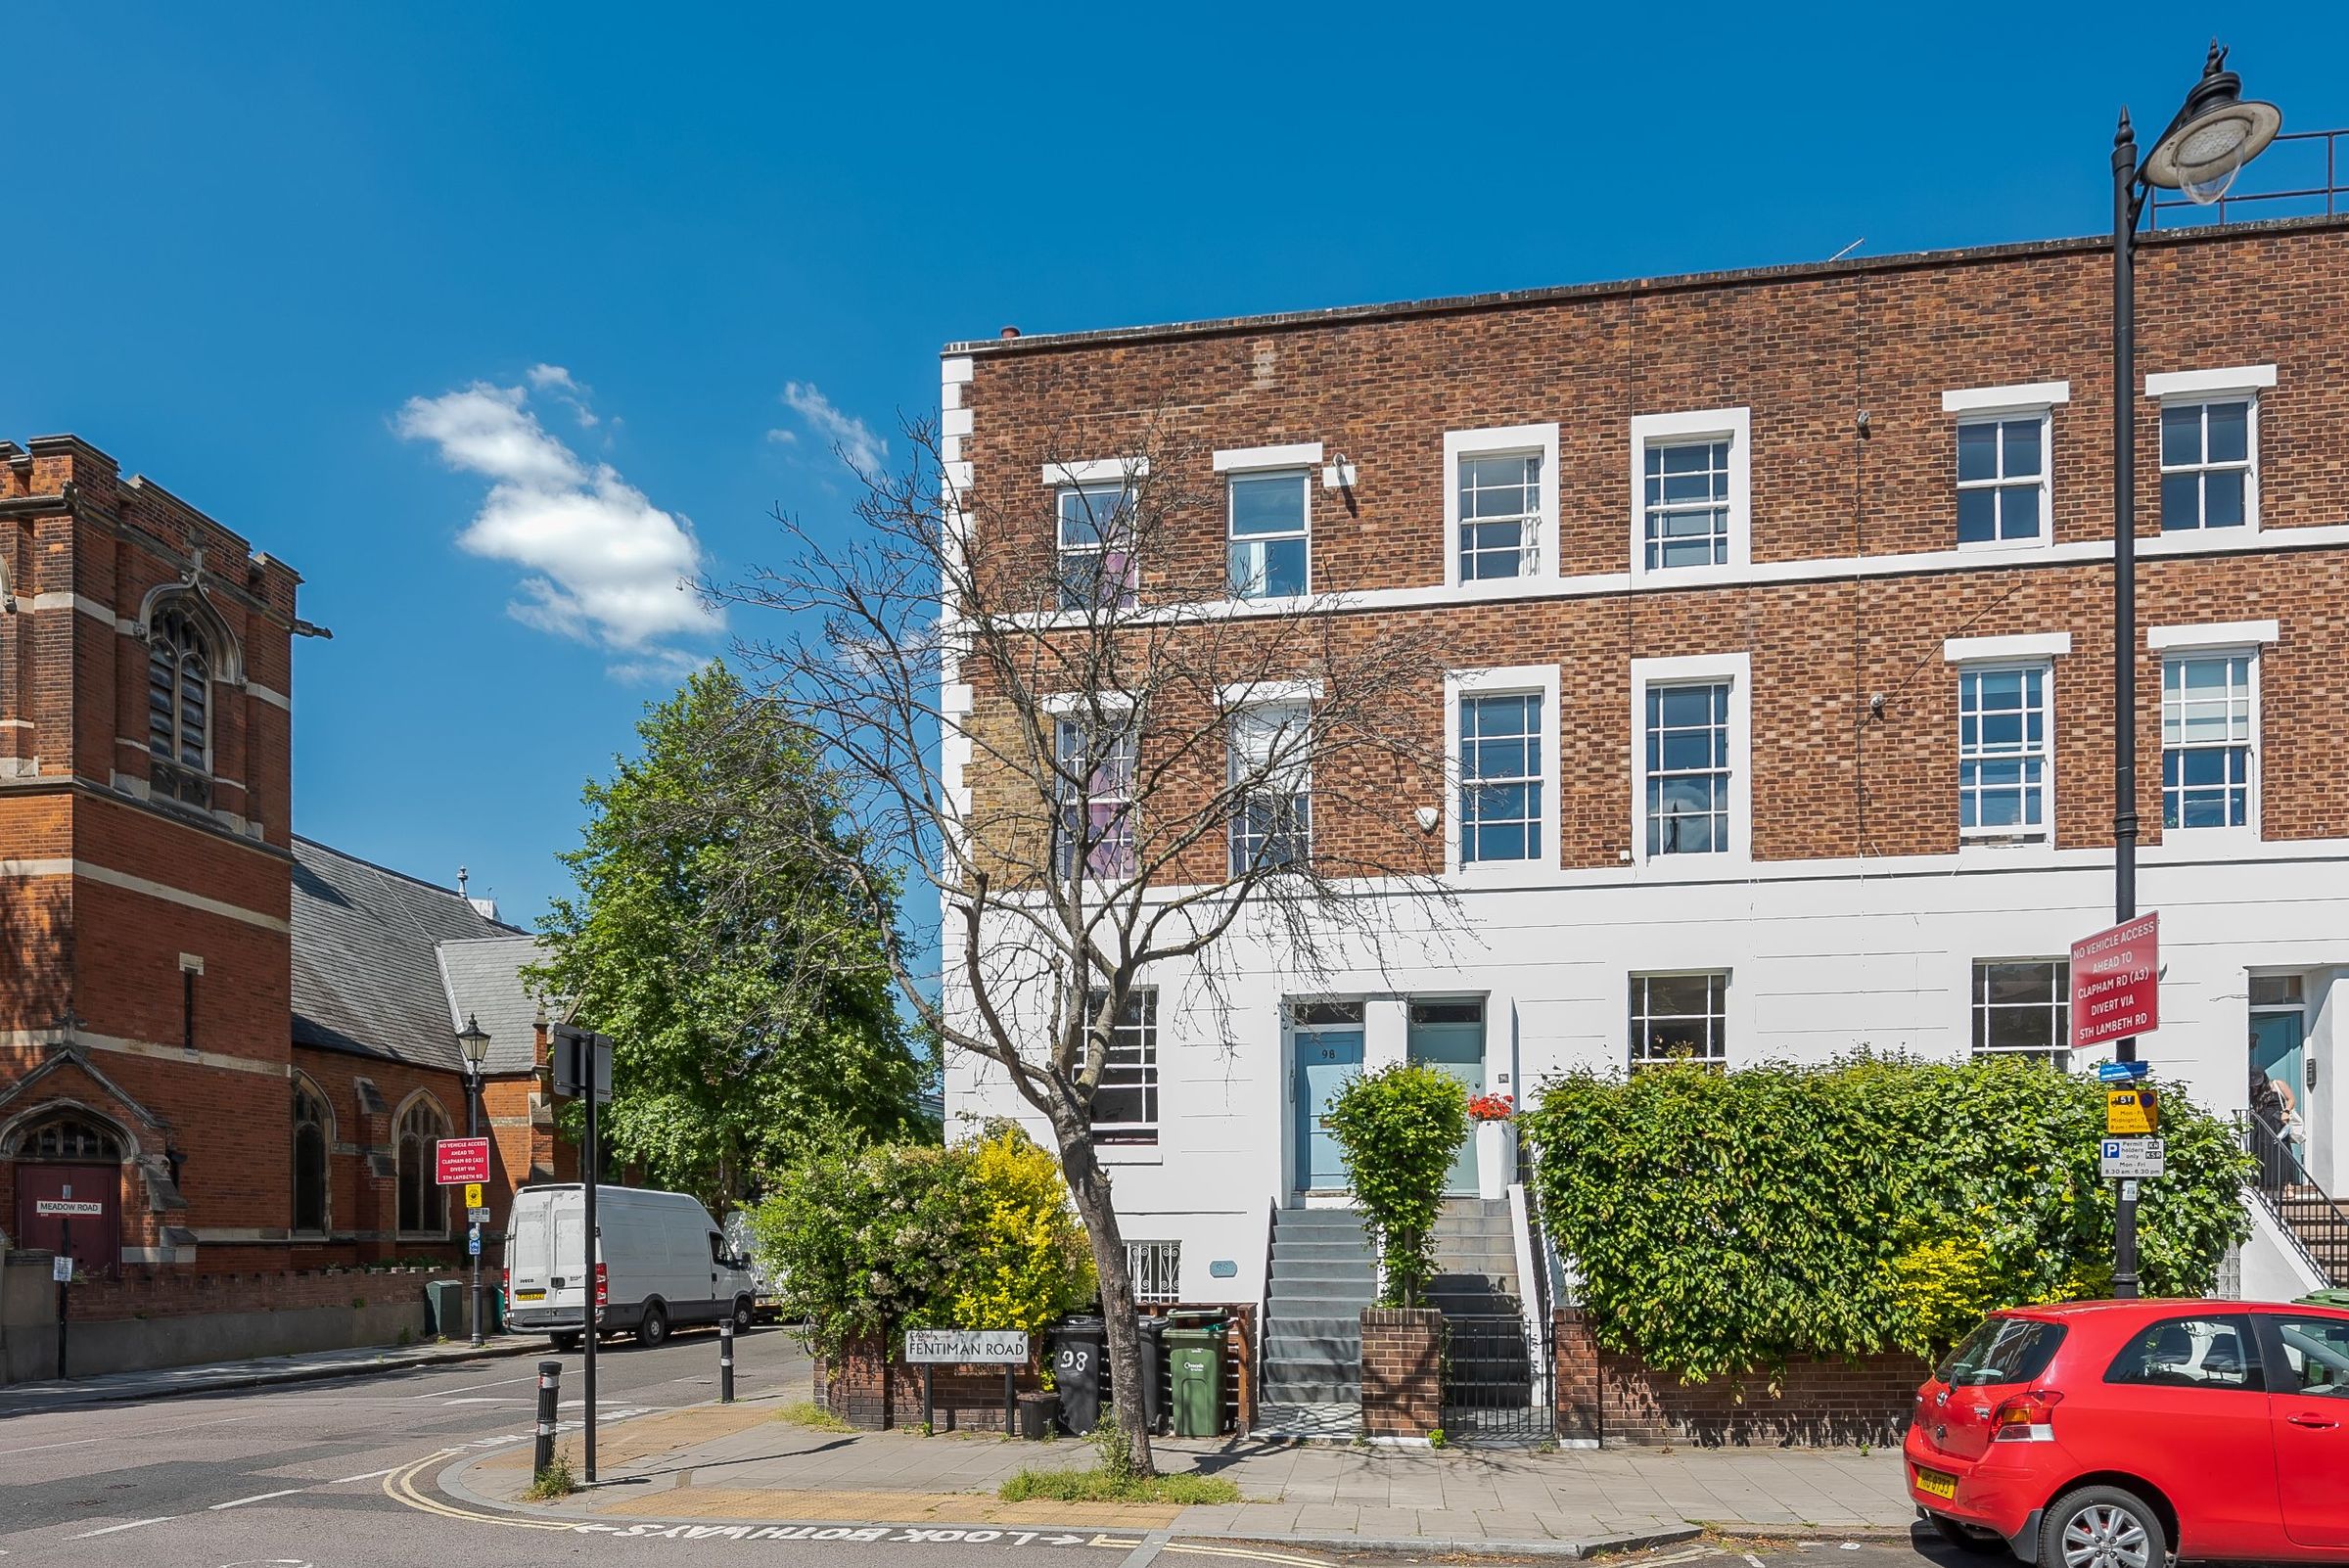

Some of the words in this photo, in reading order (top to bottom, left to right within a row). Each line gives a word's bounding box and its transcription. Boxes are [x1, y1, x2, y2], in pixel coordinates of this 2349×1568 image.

[2073, 947, 2085, 960] NO
[2087, 934, 2119, 955] VEHICLE
[2120, 921, 2154, 943] ACCESS
[2093, 956, 2119, 974] AHEAD
[2121, 951, 2132, 964] TO
[2078, 979, 2114, 999] CLAPHAM
[2116, 975, 2127, 987] RD
[2129, 967, 2149, 984] (A3)
[2091, 998, 2119, 1016] DIVERT
[2120, 994, 2134, 1008] VIA
[2079, 1028, 2094, 1039] STH
[2096, 1017, 2133, 1035] LAMBETH
[2135, 1013, 2147, 1025] RD
[1321, 1049, 1336, 1059] 98
[2107, 1144, 2118, 1157] P
[910, 1343, 980, 1355] FENTIMAN
[986, 1343, 1024, 1355] ROAD
[1060, 1350, 1088, 1371] 98
[612, 1524, 755, 1539] WAYS
[745, 1526, 893, 1542] BOTH
[889, 1528, 1039, 1545] LOOK
